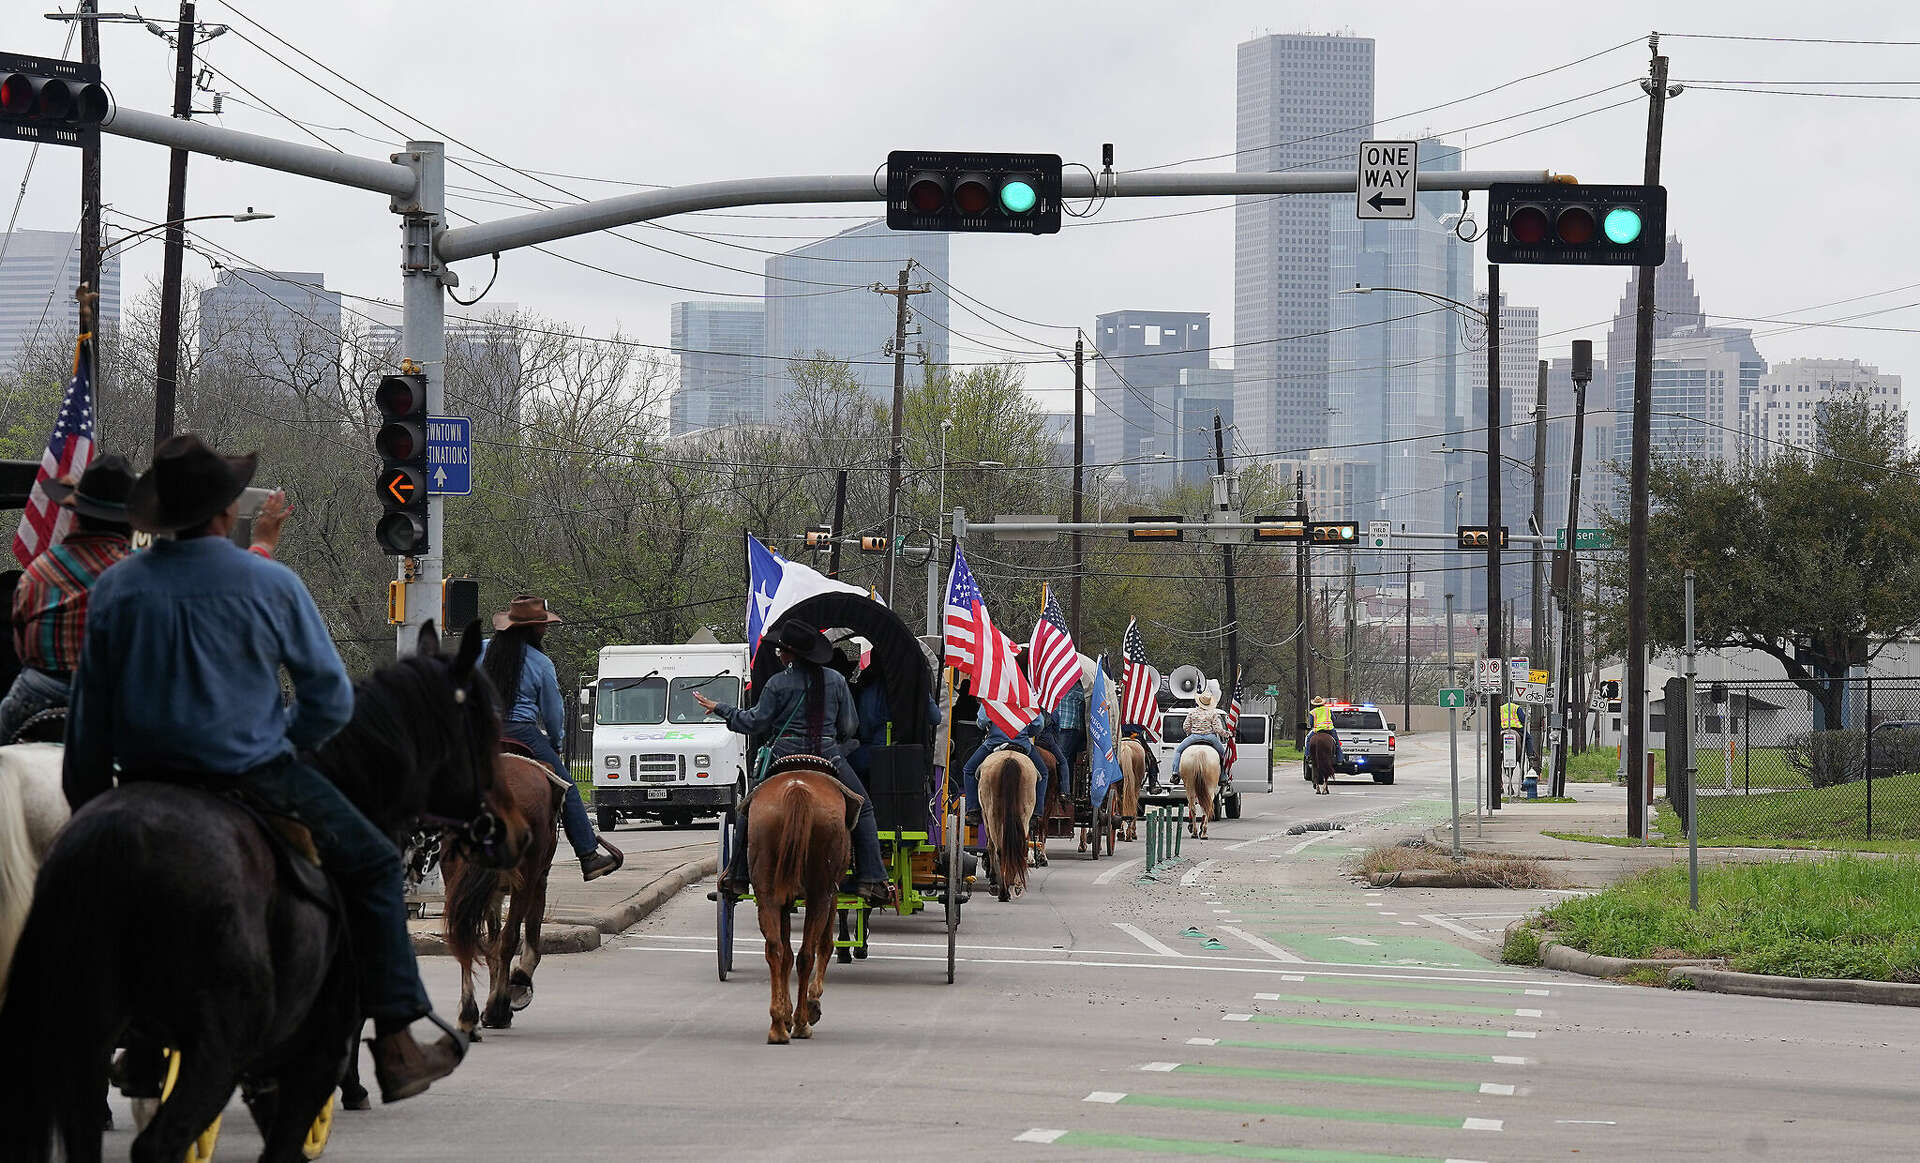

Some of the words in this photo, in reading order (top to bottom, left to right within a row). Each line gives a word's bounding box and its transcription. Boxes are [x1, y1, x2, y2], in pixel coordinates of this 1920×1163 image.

[1367, 147, 1409, 166] ONE
[1364, 169, 1410, 188] WAY
[427, 423, 462, 442] WNTOWN
[427, 445, 468, 465] TINATIONS
[1560, 530, 1594, 540] Jsen
[1592, 700, 1606, 709] 30
[623, 731, 697, 740] edEx
